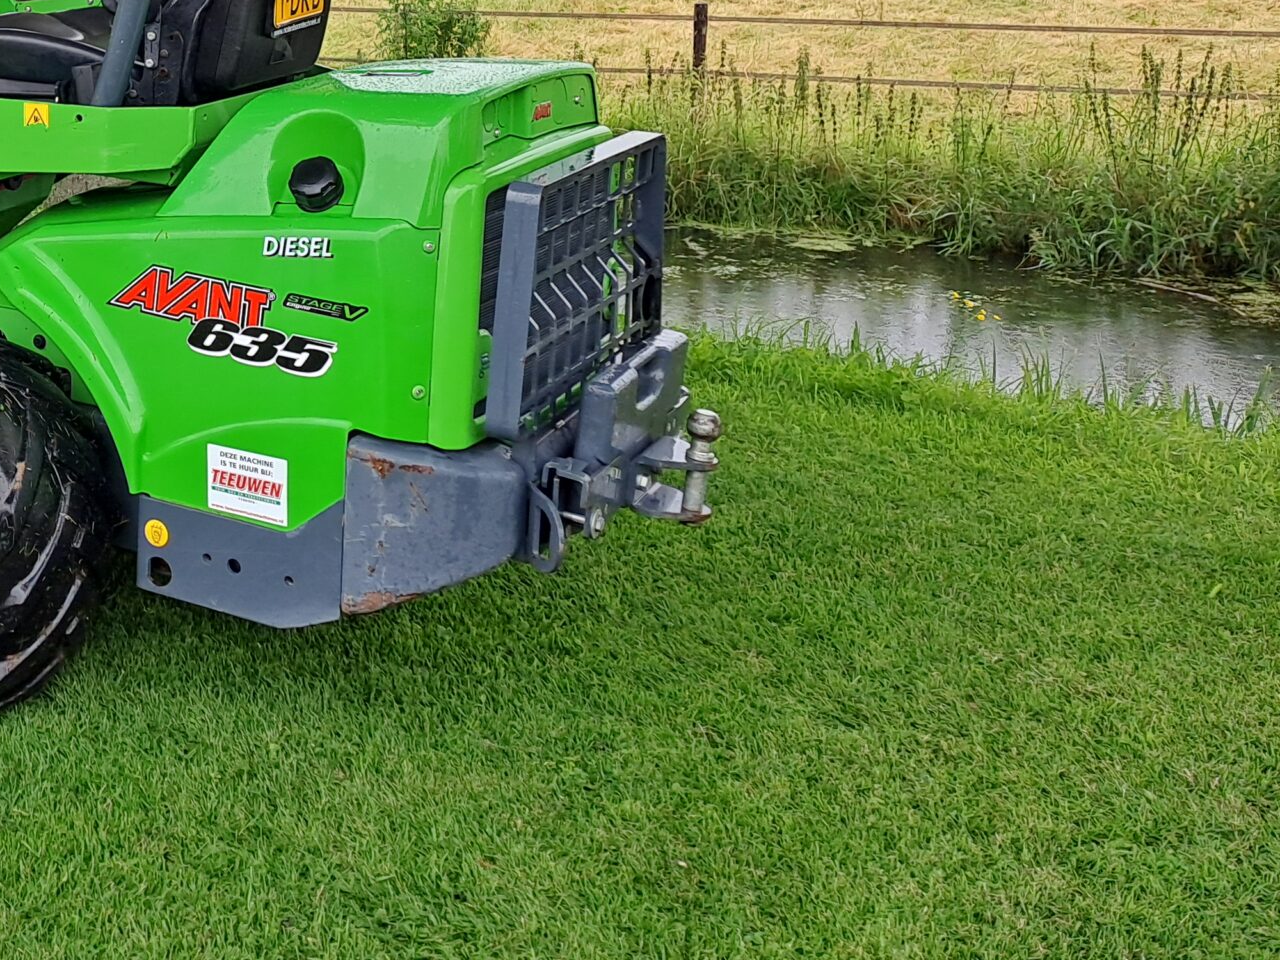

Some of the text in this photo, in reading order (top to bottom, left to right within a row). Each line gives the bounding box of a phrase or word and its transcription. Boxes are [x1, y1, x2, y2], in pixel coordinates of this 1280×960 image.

[263, 236, 334, 258] DIESEL
[108, 265, 274, 329] AVANT
[187, 317, 338, 377] 635
[219, 451, 274, 469] DEZE MACHINE
[220, 459, 227, 467] IS
[238, 464, 259, 474] HUUR
[212, 468, 283, 499] TEEUWEN
